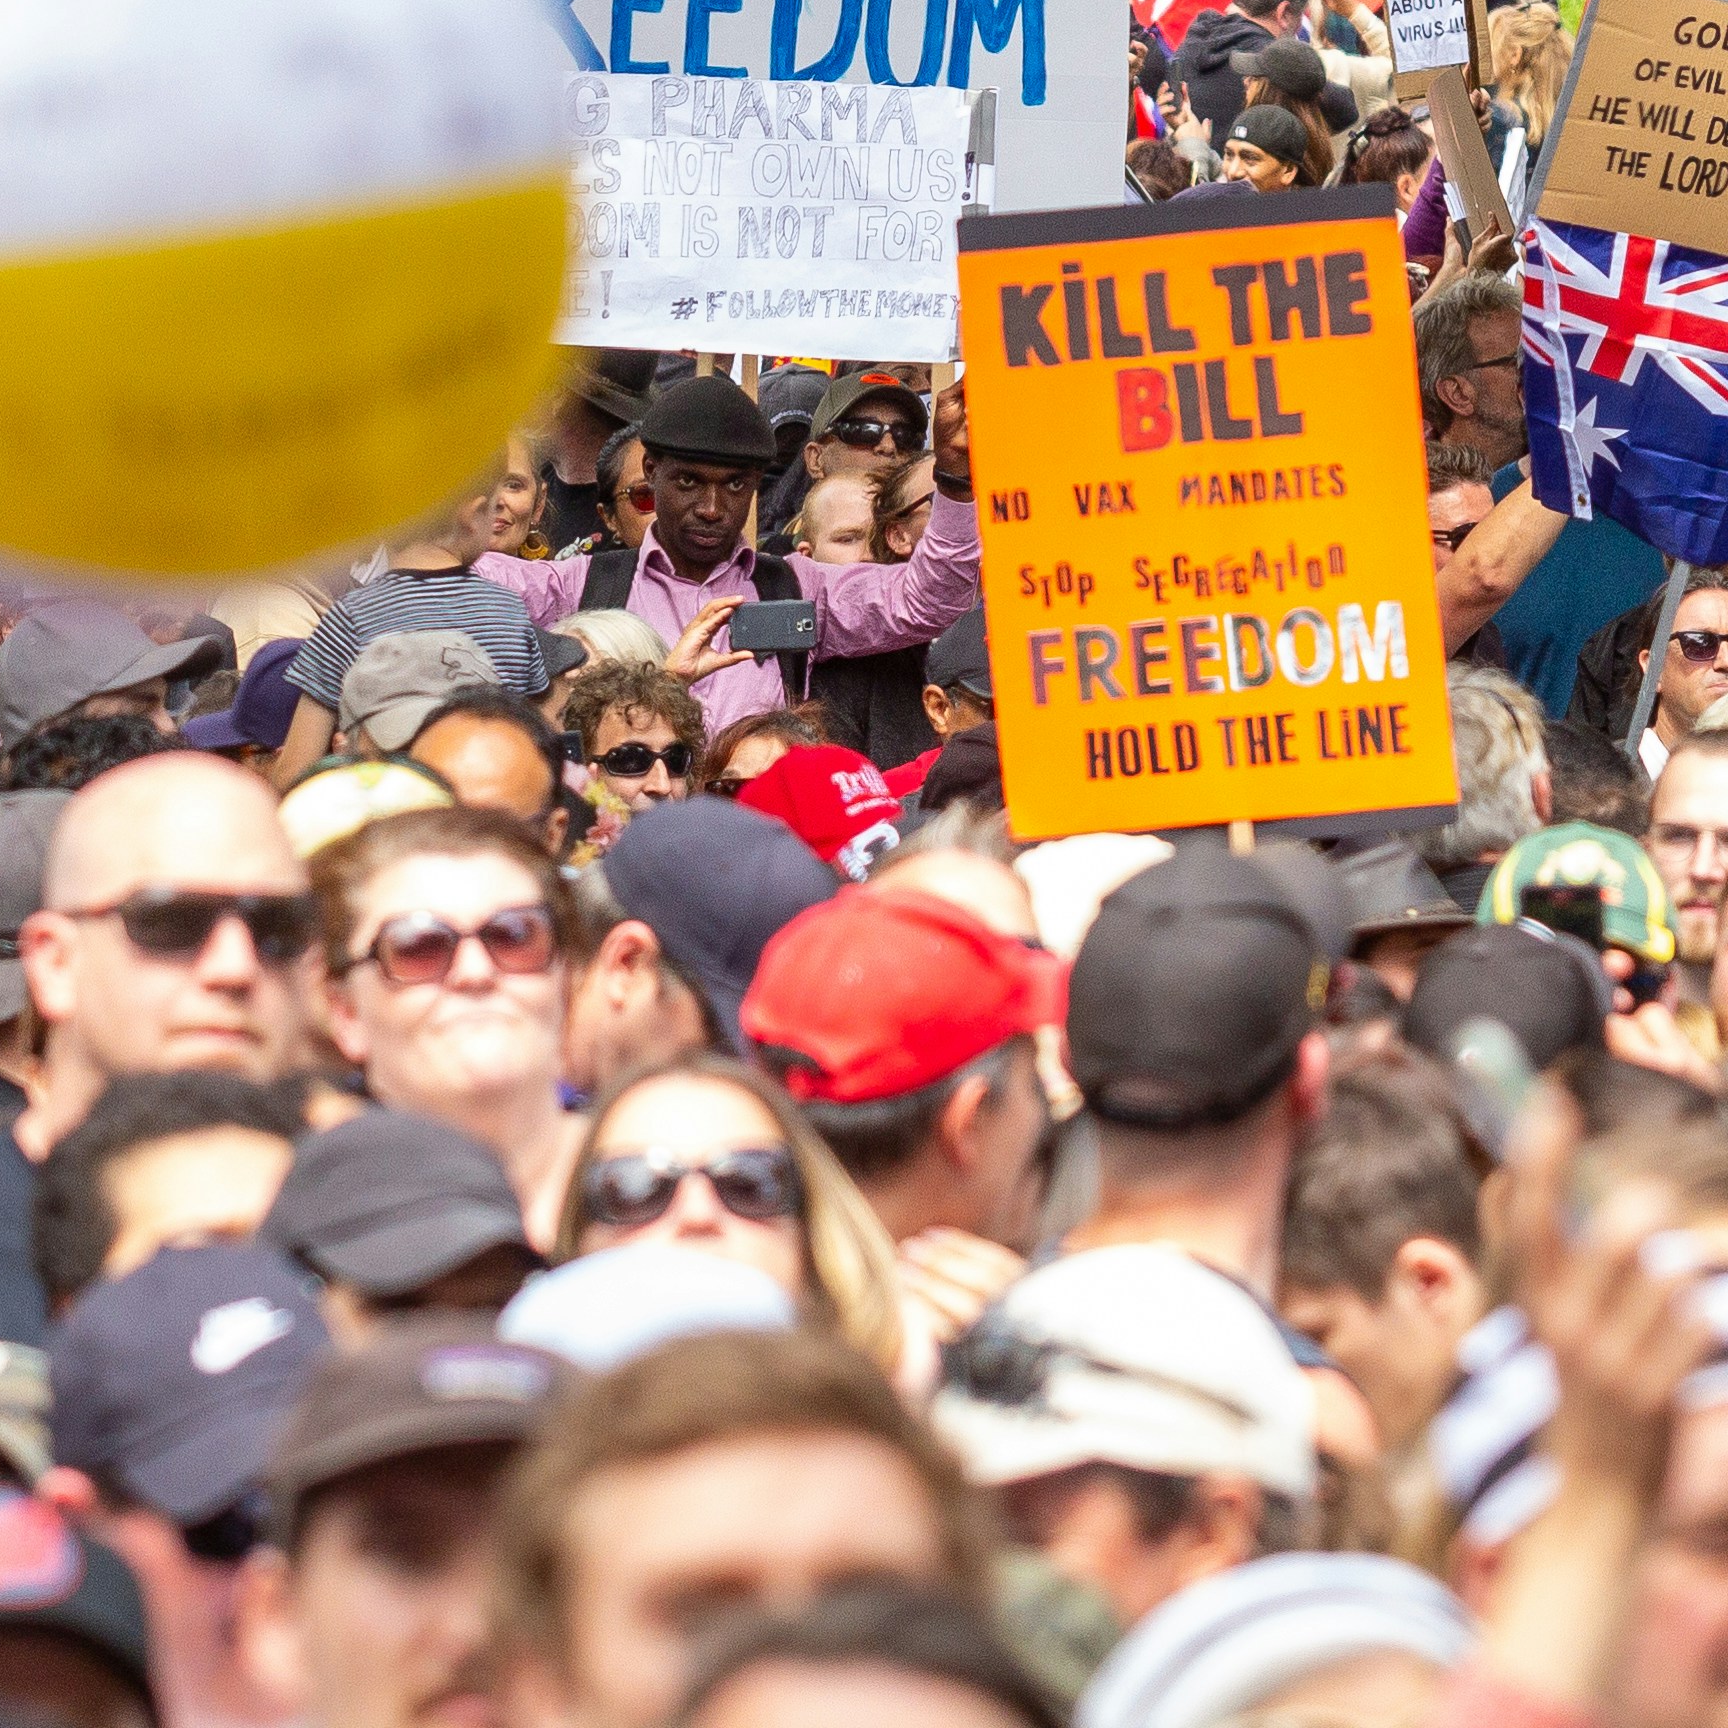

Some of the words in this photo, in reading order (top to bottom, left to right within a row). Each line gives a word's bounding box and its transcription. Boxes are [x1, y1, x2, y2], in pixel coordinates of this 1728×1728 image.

[1634, 58, 1671, 82] OF
[1675, 65, 1727, 95] EVIL
[650, 76, 918, 145] PHARMA
[1588, 95, 1632, 125] HE
[1638, 101, 1696, 141] WILL
[643, 139, 734, 197] NOT
[750, 143, 871, 202] OWN
[1606, 145, 1652, 179] THE
[680, 204, 720, 259] IS
[736, 205, 835, 259] NOT
[856, 205, 943, 263] FOR
[1212, 250, 1373, 347] THE
[1115, 354, 1305, 454] BILL
[989, 485, 1030, 525] NO
[1072, 479, 1137, 519] VAX
[1178, 462, 1348, 510] MANDATES
[1027, 599, 1410, 707] FREEDOM
[1085, 722, 1200, 780] HOLD
[1217, 710, 1299, 768] THE
